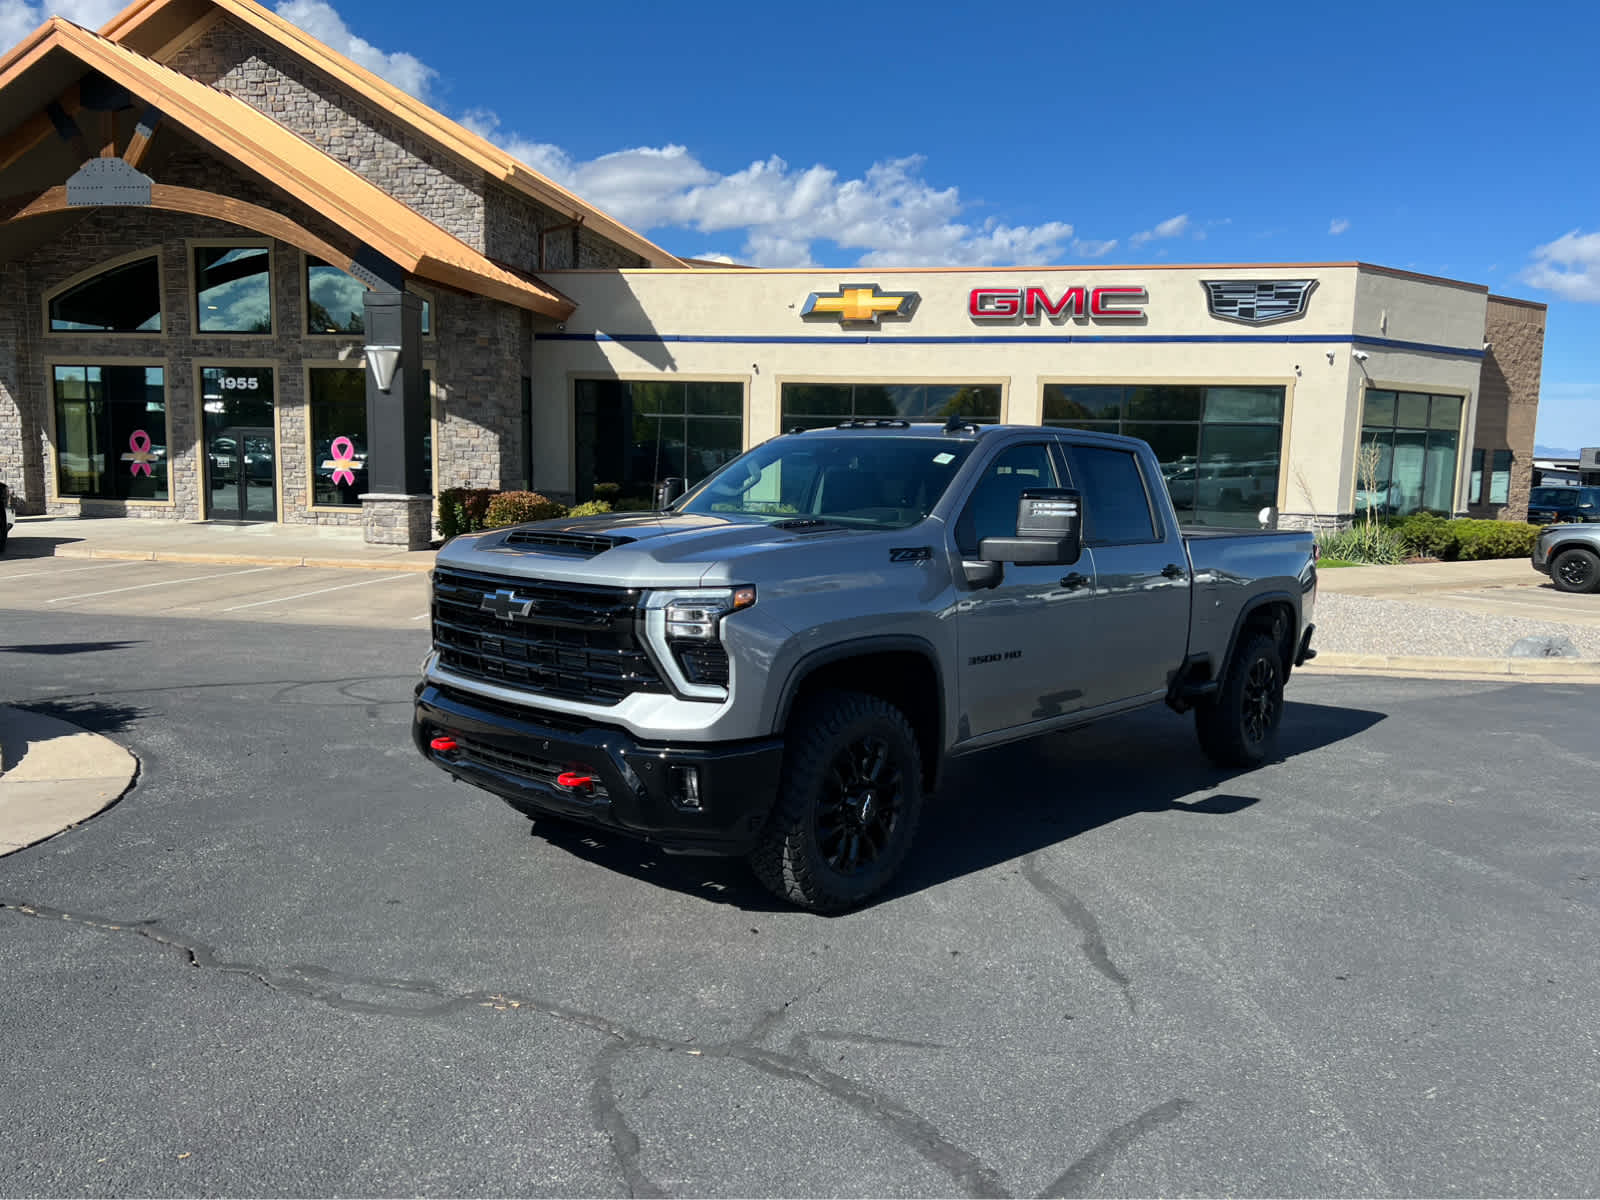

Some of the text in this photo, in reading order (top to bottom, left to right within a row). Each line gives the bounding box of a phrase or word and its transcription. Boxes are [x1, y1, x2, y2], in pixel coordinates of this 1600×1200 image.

[968, 286, 1147, 320] GMC
[217, 377, 259, 390] 1955
[967, 653, 1001, 666] 3500
